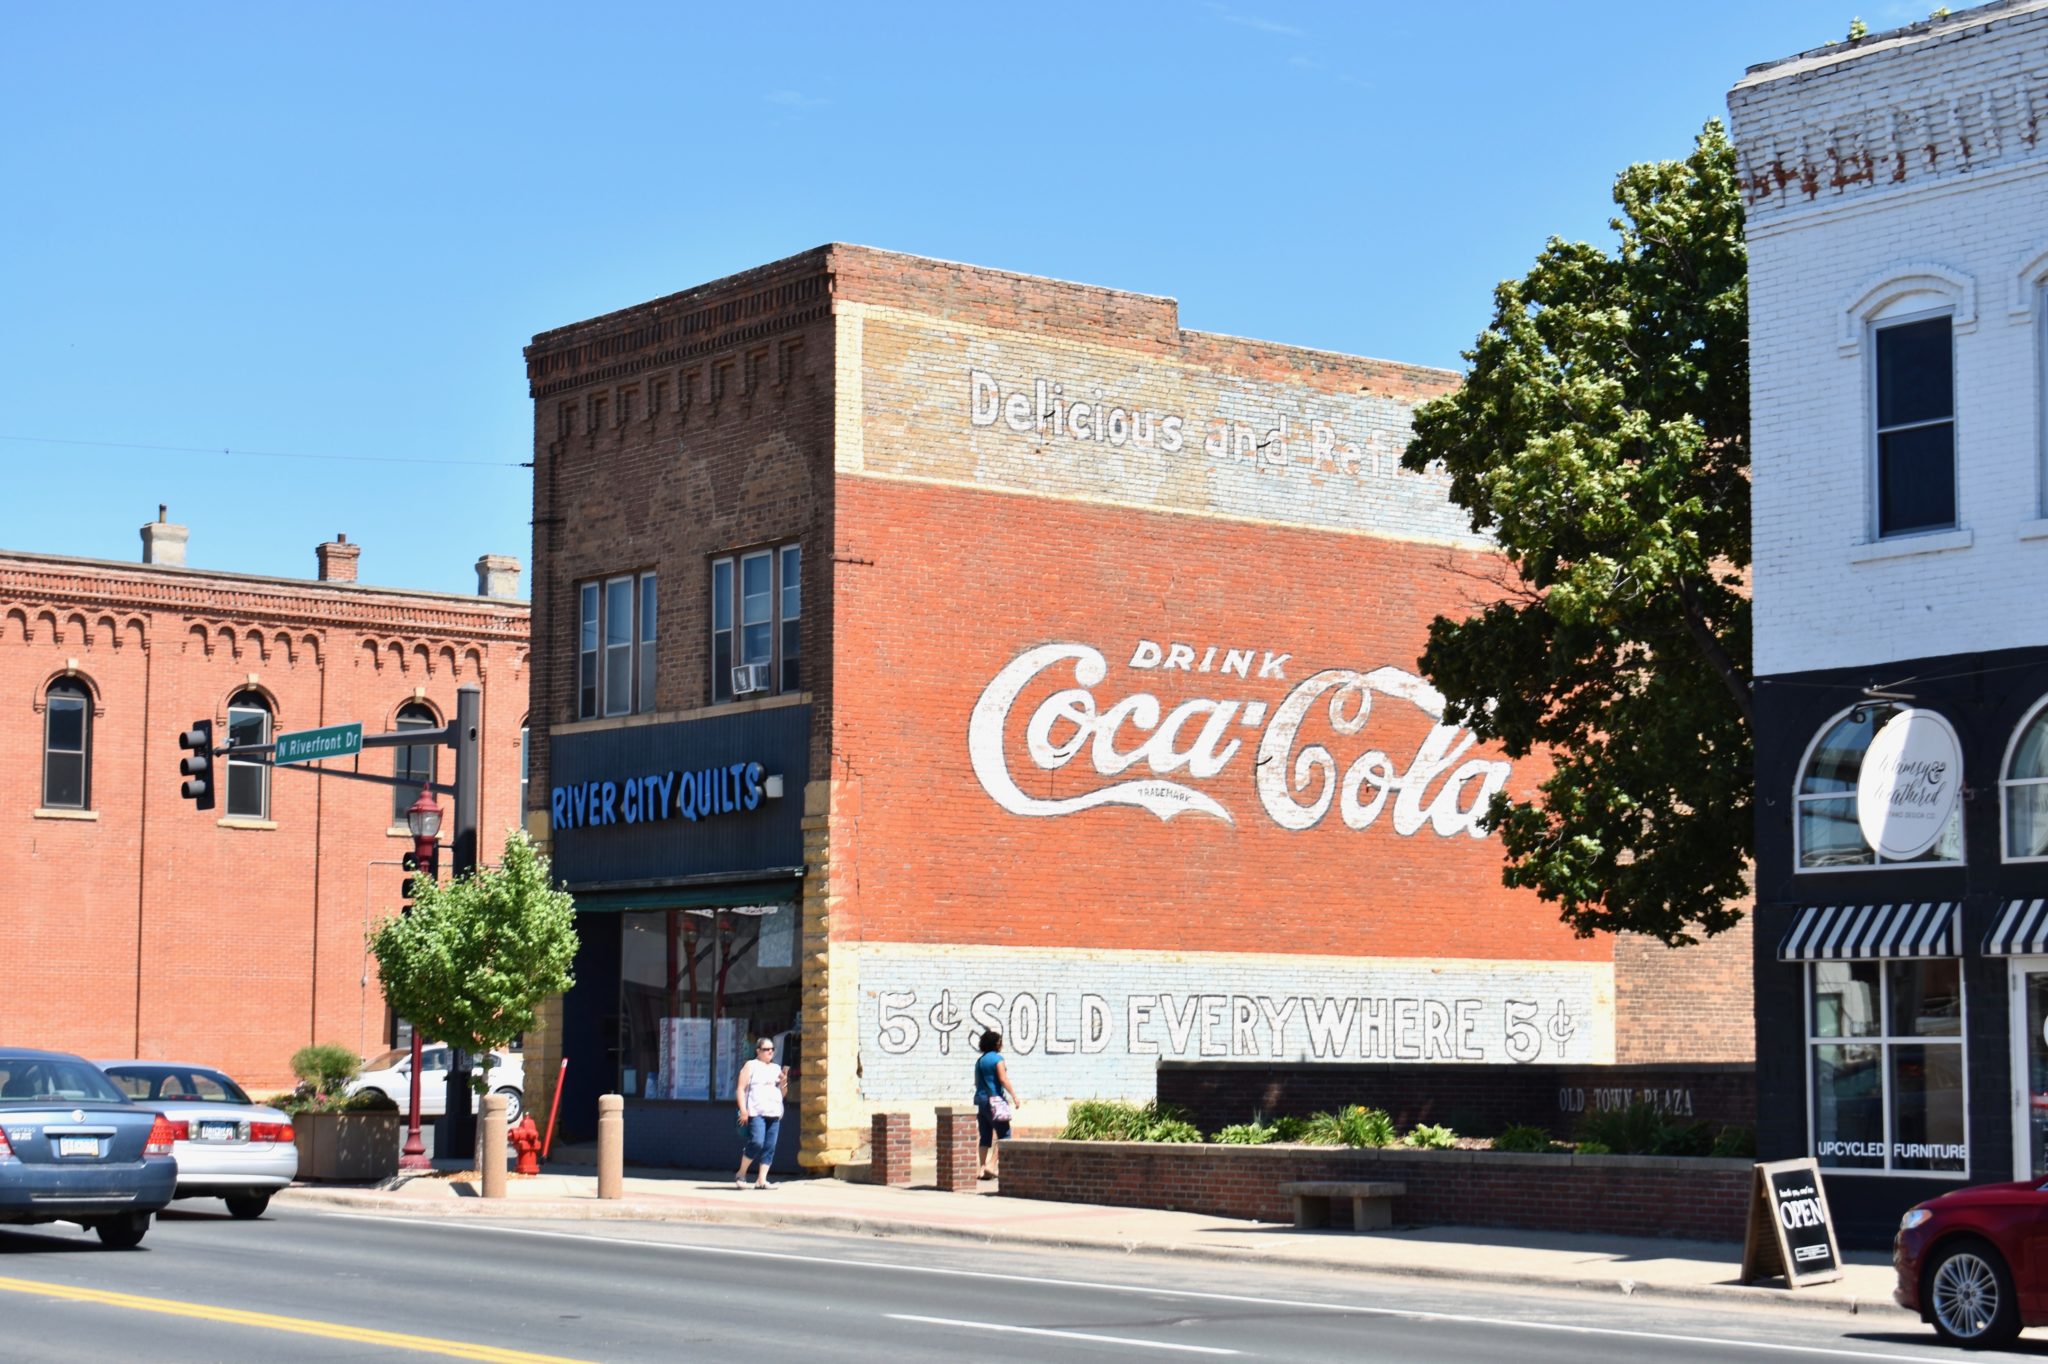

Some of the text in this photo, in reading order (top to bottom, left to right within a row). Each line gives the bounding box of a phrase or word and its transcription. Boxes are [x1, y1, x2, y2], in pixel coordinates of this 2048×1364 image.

[970, 368, 1184, 452] Delicious
[1204, 413, 1288, 466] and
[1127, 638, 1293, 680] DRINK
[278, 731, 359, 758] N Riverfront Dr
[552, 761, 768, 831] RIVER CITY QUILTS
[1137, 787, 1192, 803] TRADEMARK
[877, 988, 1577, 1064] 5¢ SOLD EVERYWHERE 5¢
[1559, 1087, 1694, 1117] OLD TOWN PLAZA
[1817, 1141, 1968, 1159] UPCYCLED FURNITURE
[1780, 1196, 1826, 1230] OPEN
